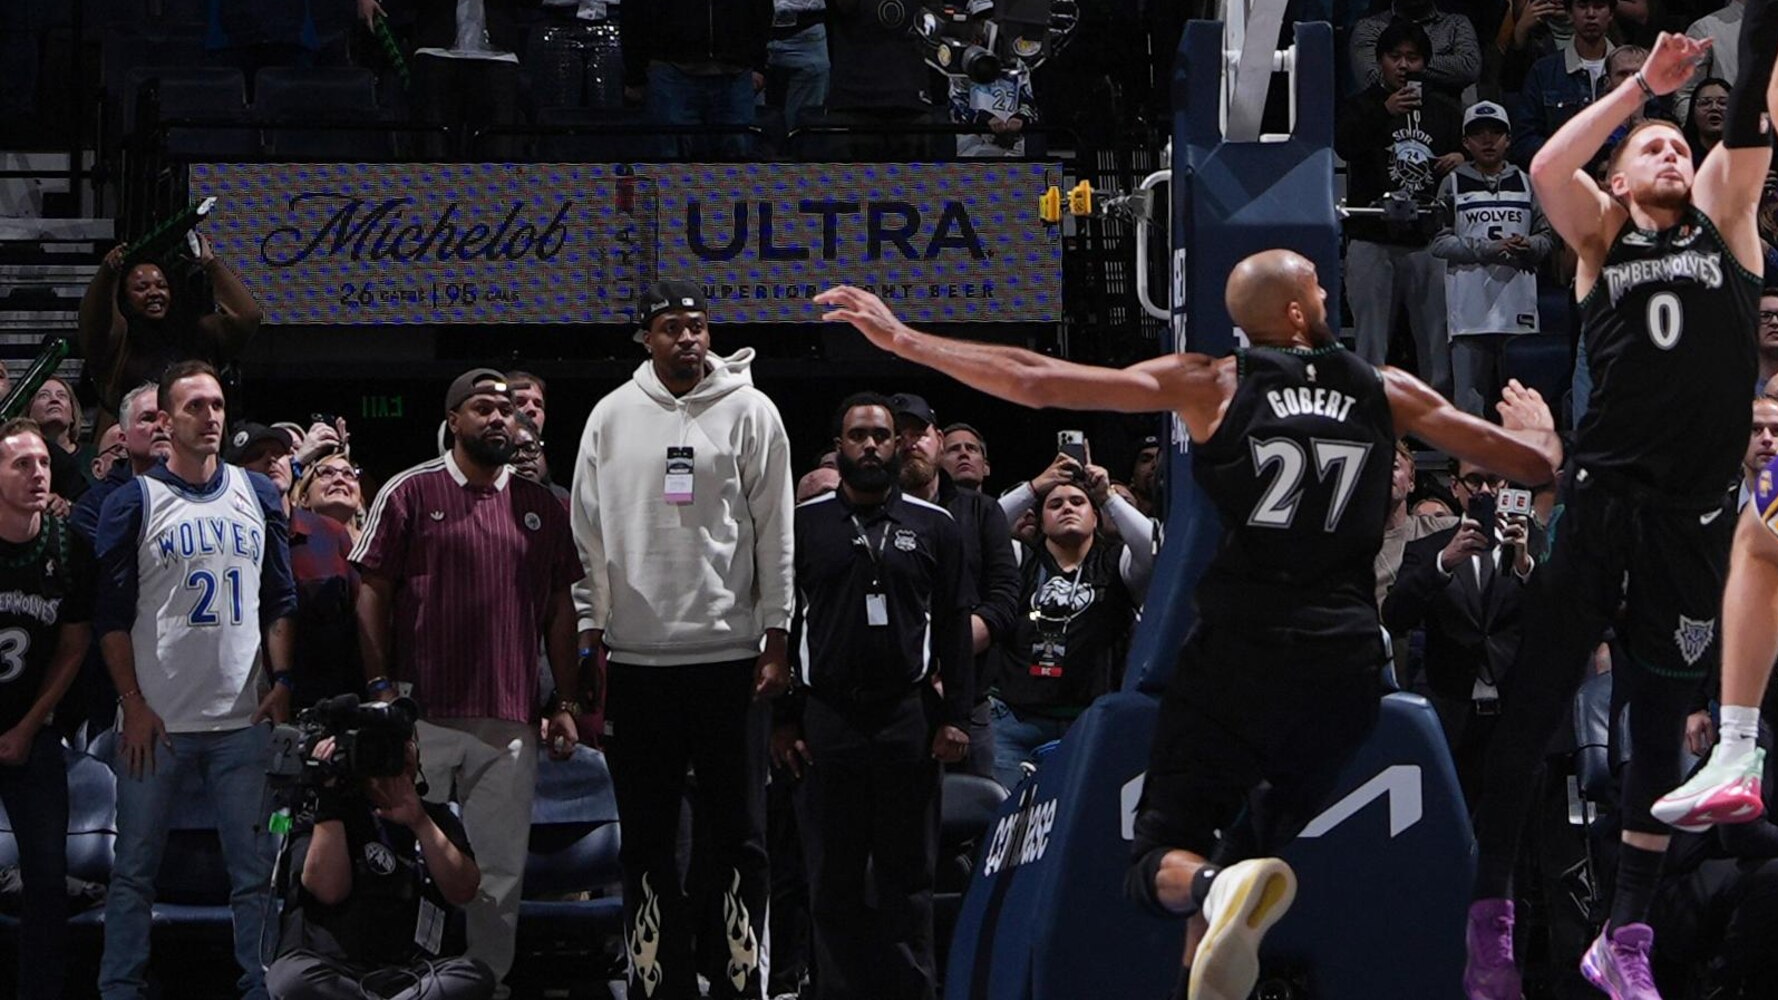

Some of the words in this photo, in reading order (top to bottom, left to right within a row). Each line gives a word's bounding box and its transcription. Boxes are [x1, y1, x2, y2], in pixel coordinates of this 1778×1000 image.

[992, 88, 1018, 113] 27
[260, 191, 572, 268] Michelob
[687, 201, 988, 262] ULTRA
[1465, 210, 1522, 224] WOLVES
[702, 284, 818, 300] UPERIOR
[928, 284, 994, 299] BEER
[1602, 250, 1724, 291] TIMBERWOLVES
[340, 282, 374, 306] 26
[1646, 290, 1685, 351] 0
[1266, 386, 1357, 423] GOBERT
[1247, 435, 1374, 534] 27
[156, 515, 262, 566] WOLVES
[185, 566, 244, 627] 21
